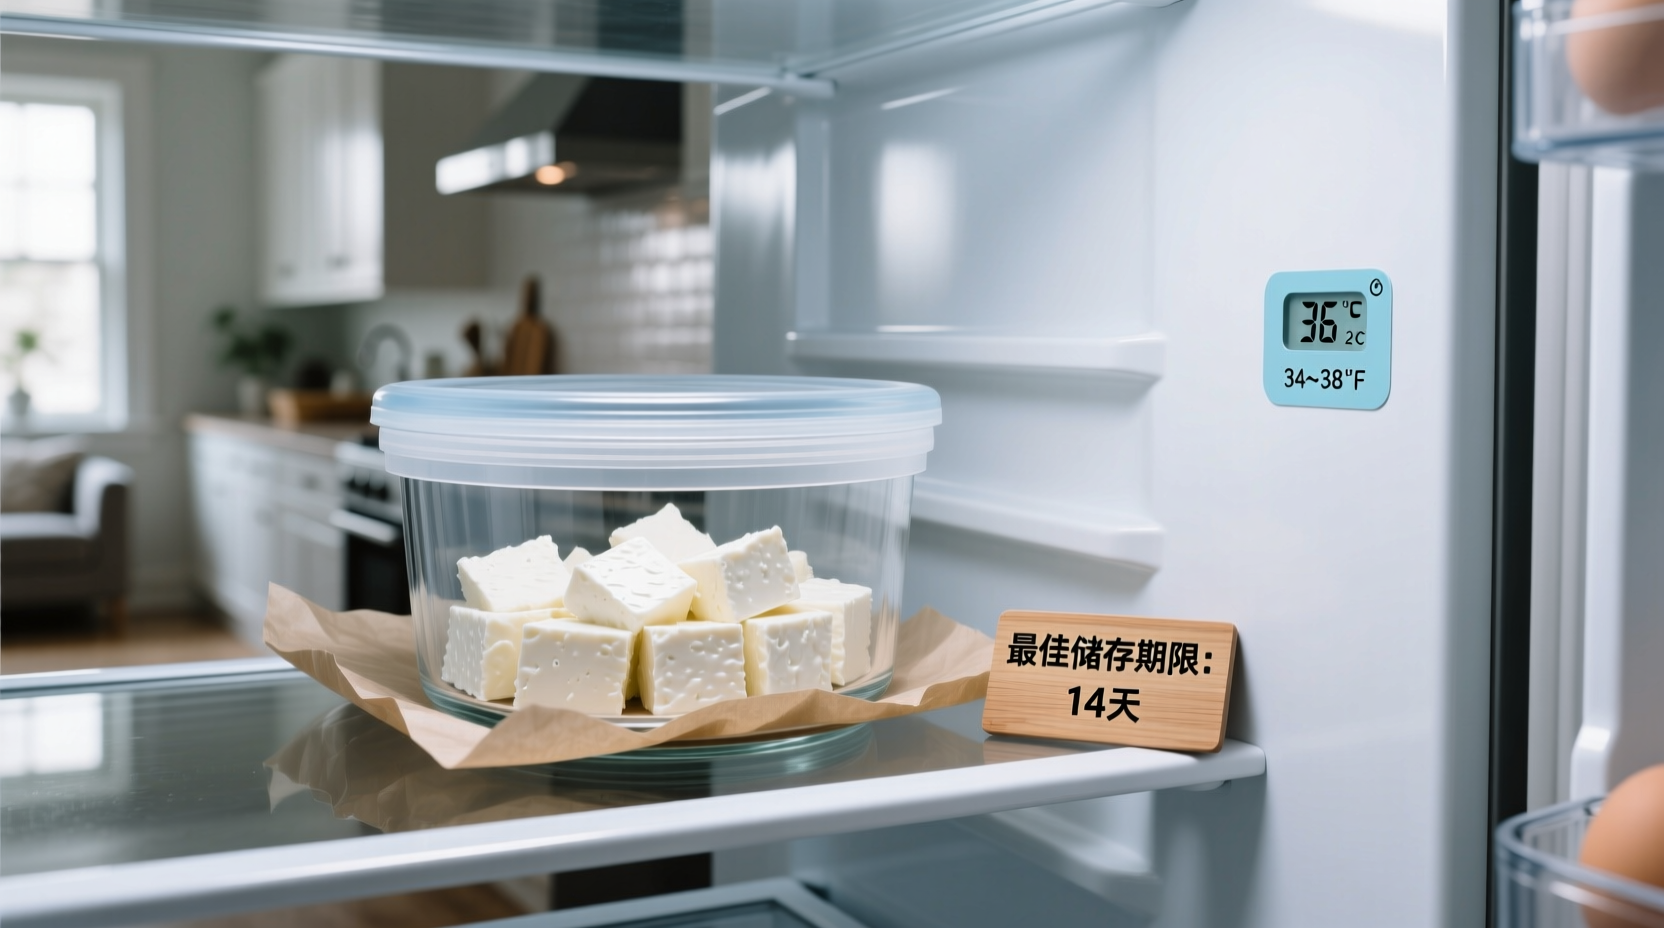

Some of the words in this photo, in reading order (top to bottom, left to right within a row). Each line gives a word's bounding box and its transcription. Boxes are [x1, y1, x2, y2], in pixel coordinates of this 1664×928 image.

[1300, 300, 1338, 344] 36
[1344, 330, 1366, 346] 2C
[1006, 632, 1214, 676] 最佳储存期限：
[1068, 685, 1141, 724] 14天
